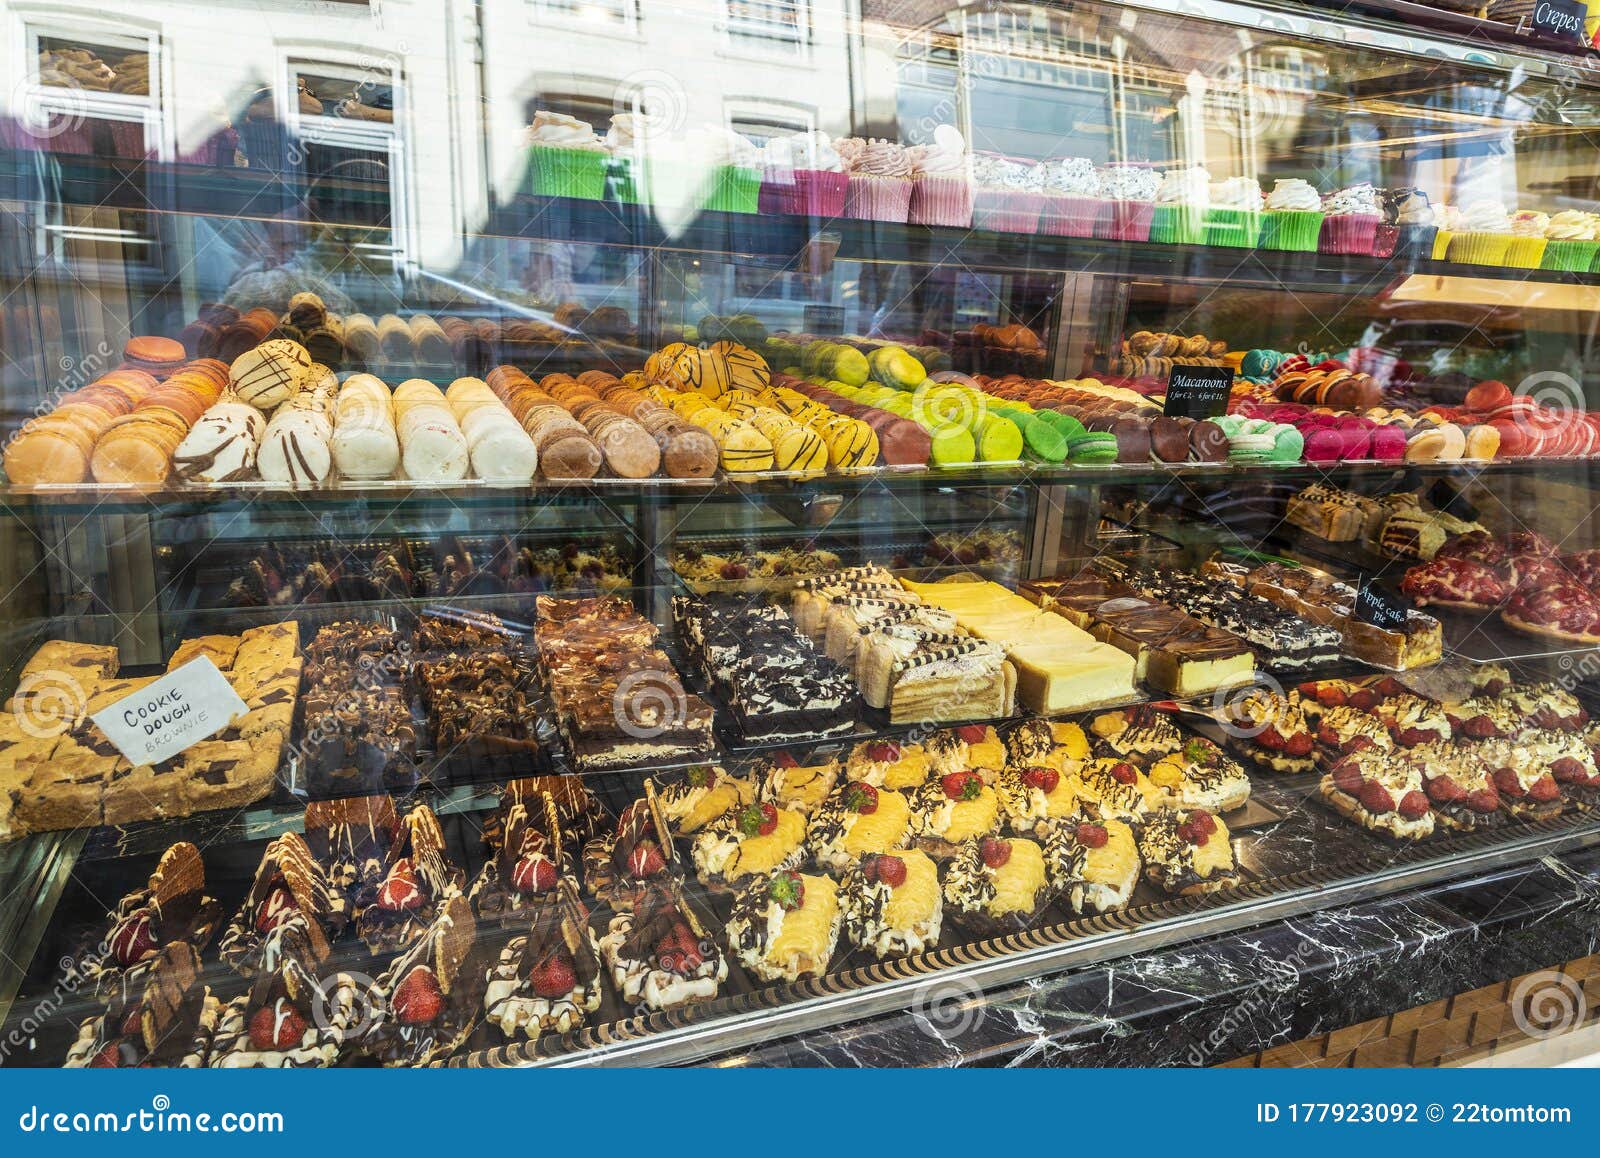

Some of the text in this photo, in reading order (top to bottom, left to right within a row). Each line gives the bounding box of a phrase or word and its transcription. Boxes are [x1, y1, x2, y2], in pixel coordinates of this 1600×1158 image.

[1536, 2, 1581, 34] Crepes
[1172, 375, 1228, 389] Macaroons
[1358, 586, 1385, 610] Apple
[1373, 610, 1386, 623] pie
[123, 687, 183, 728] COOKIE
[143, 703, 191, 736] DOUGH
[145, 711, 209, 753] BROWNIE
